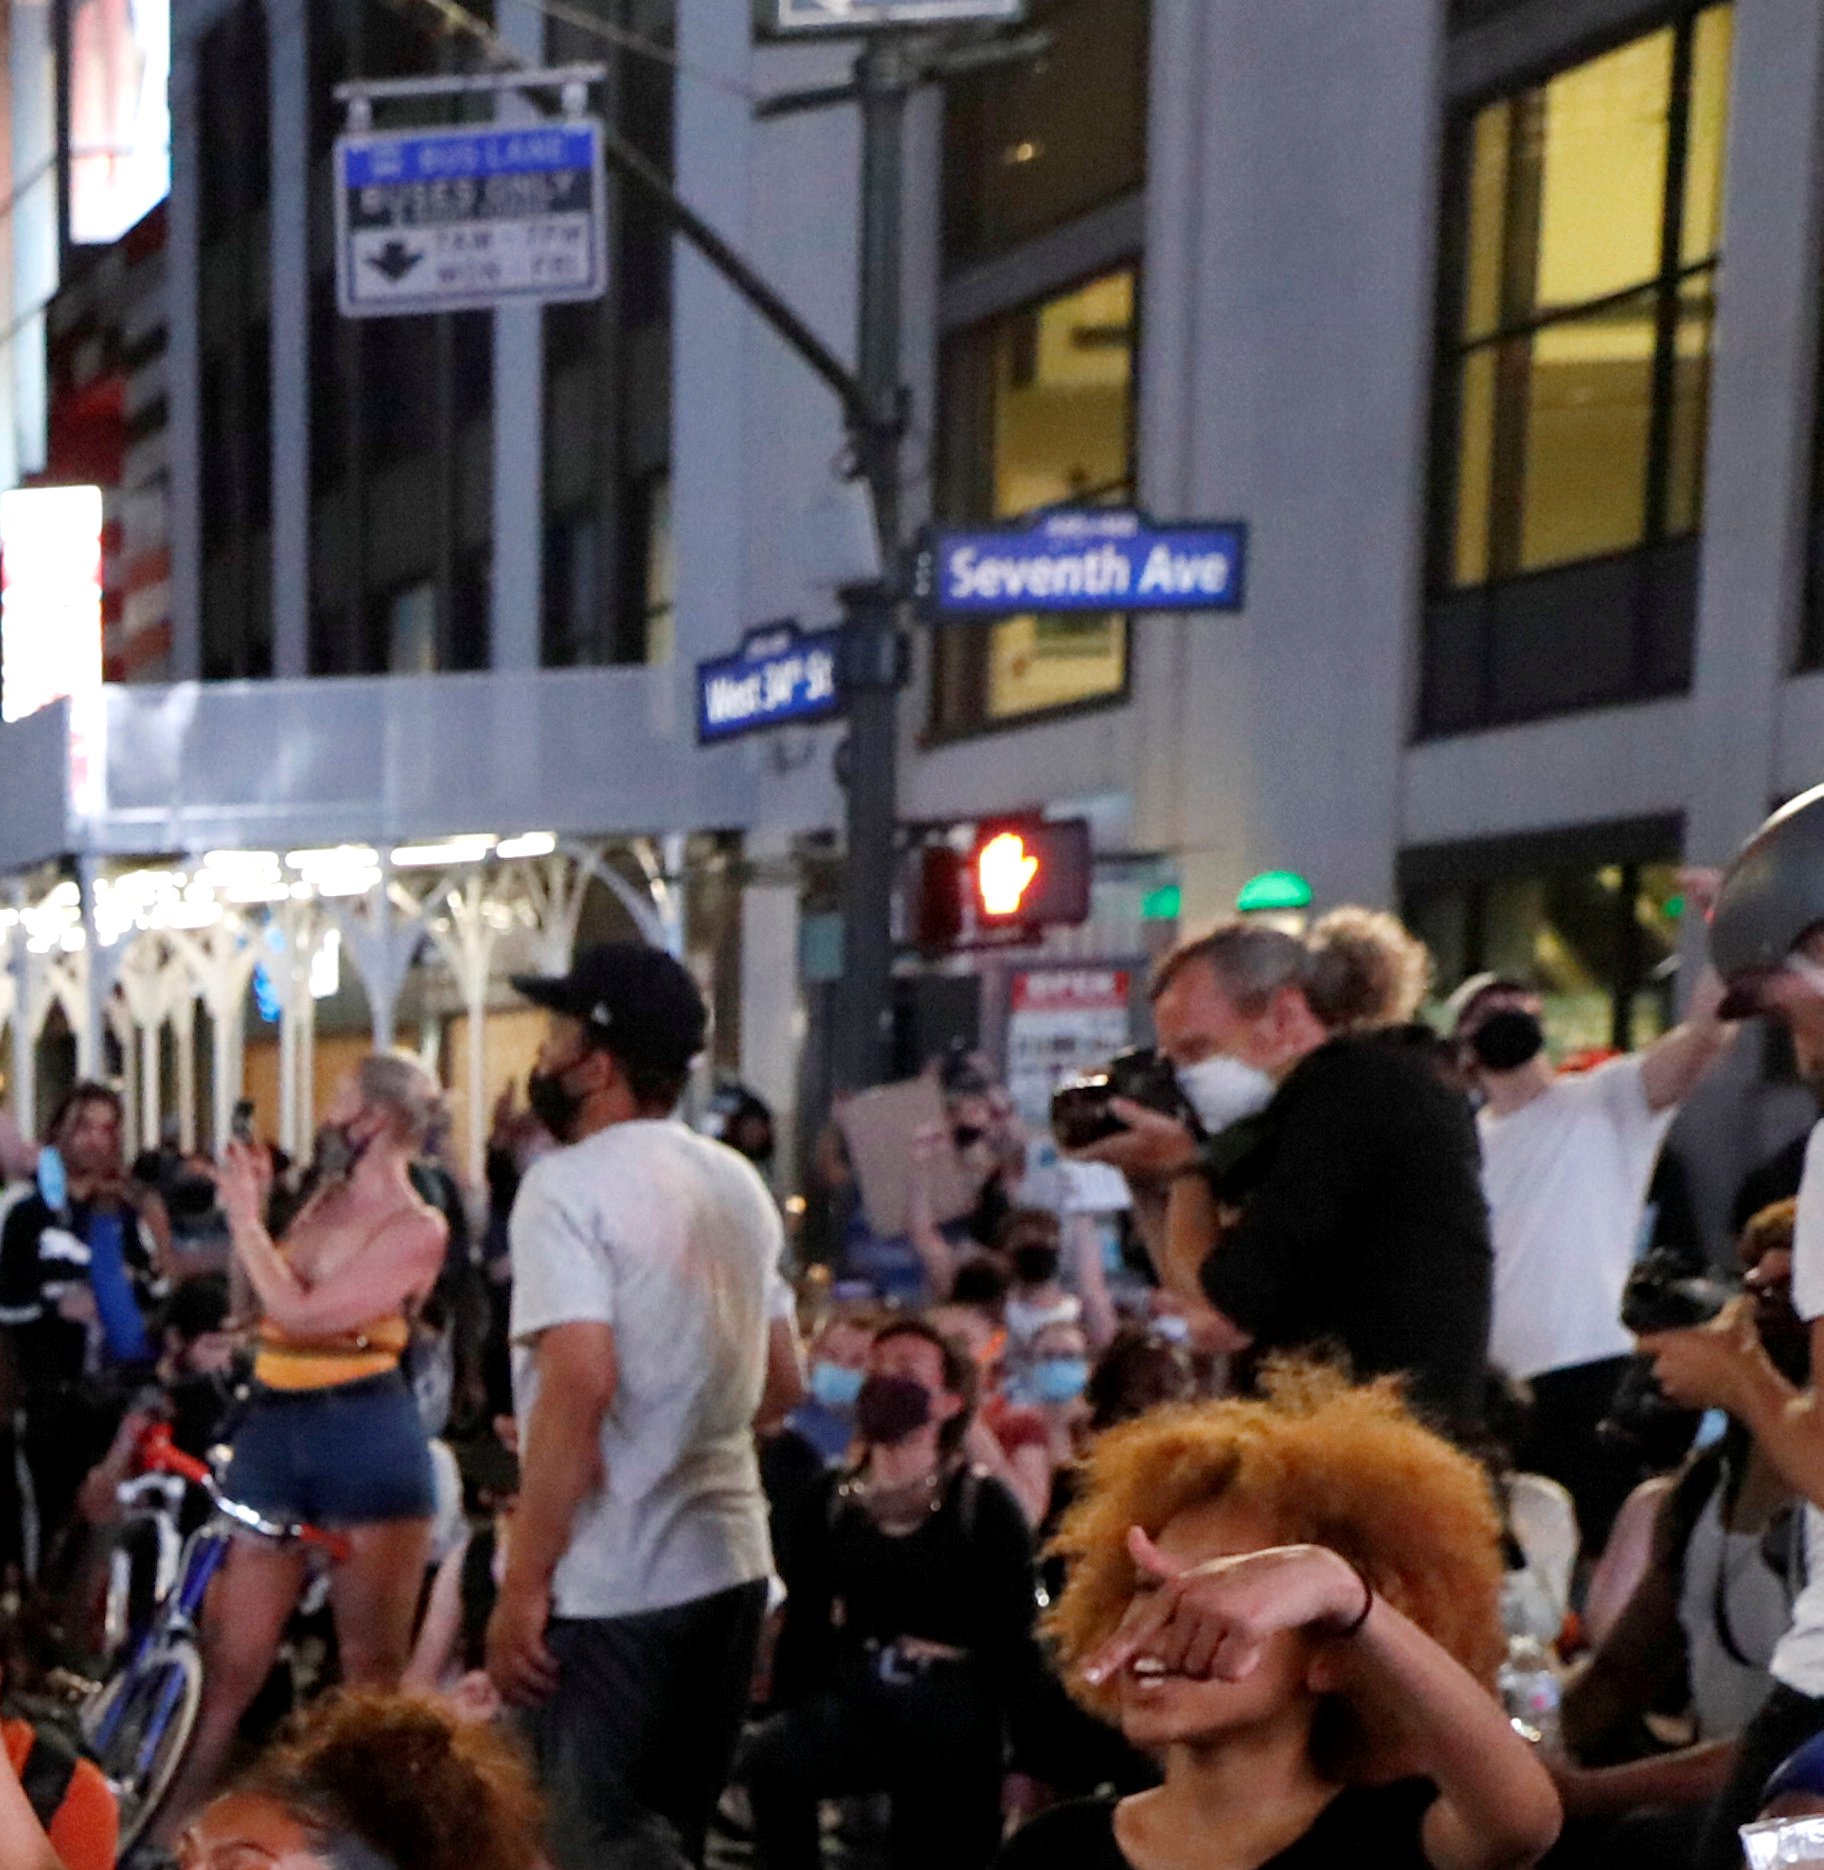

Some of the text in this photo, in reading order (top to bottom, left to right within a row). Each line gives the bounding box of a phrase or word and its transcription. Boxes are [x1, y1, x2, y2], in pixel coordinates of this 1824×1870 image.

[950, 544, 1228, 597] Seventh Ave
[705, 673, 761, 724] West
